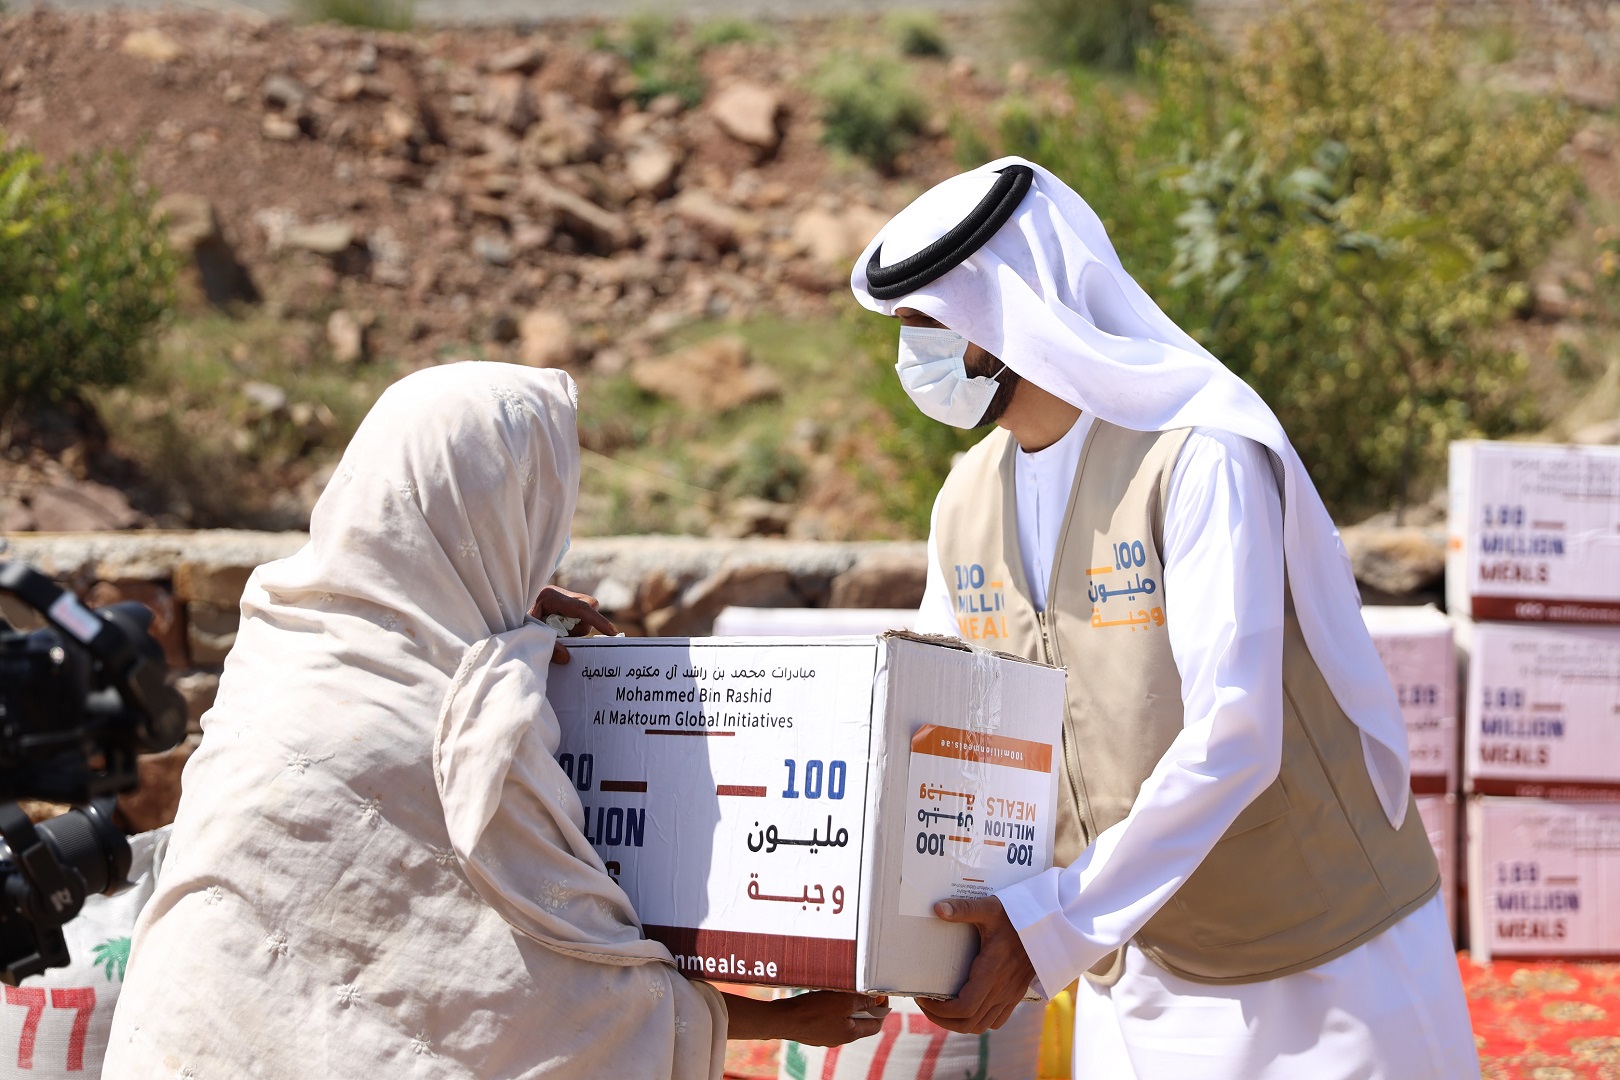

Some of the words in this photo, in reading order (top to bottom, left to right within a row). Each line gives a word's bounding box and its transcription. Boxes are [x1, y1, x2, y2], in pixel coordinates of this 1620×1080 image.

[1112, 540, 1146, 570] 100
[955, 564, 984, 590] 100
[1087, 573, 1156, 603] مليون
[1091, 606, 1165, 632] وجبة
[581, 666, 621, 680] العالمية
[625, 665, 660, 680] مكتوم
[682, 665, 707, 681] راشد
[713, 666, 725, 681] بن
[731, 668, 766, 679] محمد
[772, 666, 816, 681] مبادرات
[615, 686, 695, 702] Mohammed
[699, 687, 721, 703] Bin
[726, 687, 772, 703] Rashid
[592, 709, 606, 725] Al
[609, 709, 671, 726] Maktoum
[675, 711, 720, 727] Global
[723, 712, 793, 728] Initiatives
[559, 753, 594, 791] 00
[782, 758, 847, 800] 100
[986, 796, 1037, 822] MEALS
[584, 806, 645, 847] LION
[747, 815, 849, 854] مليون
[984, 820, 1035, 842] MILLION
[916, 831, 946, 857] 100
[1006, 843, 1033, 867] 100
[747, 872, 845, 914] وجبة
[674, 953, 778, 978] nmeals.ae
[0, 985, 96, 1071] 77
